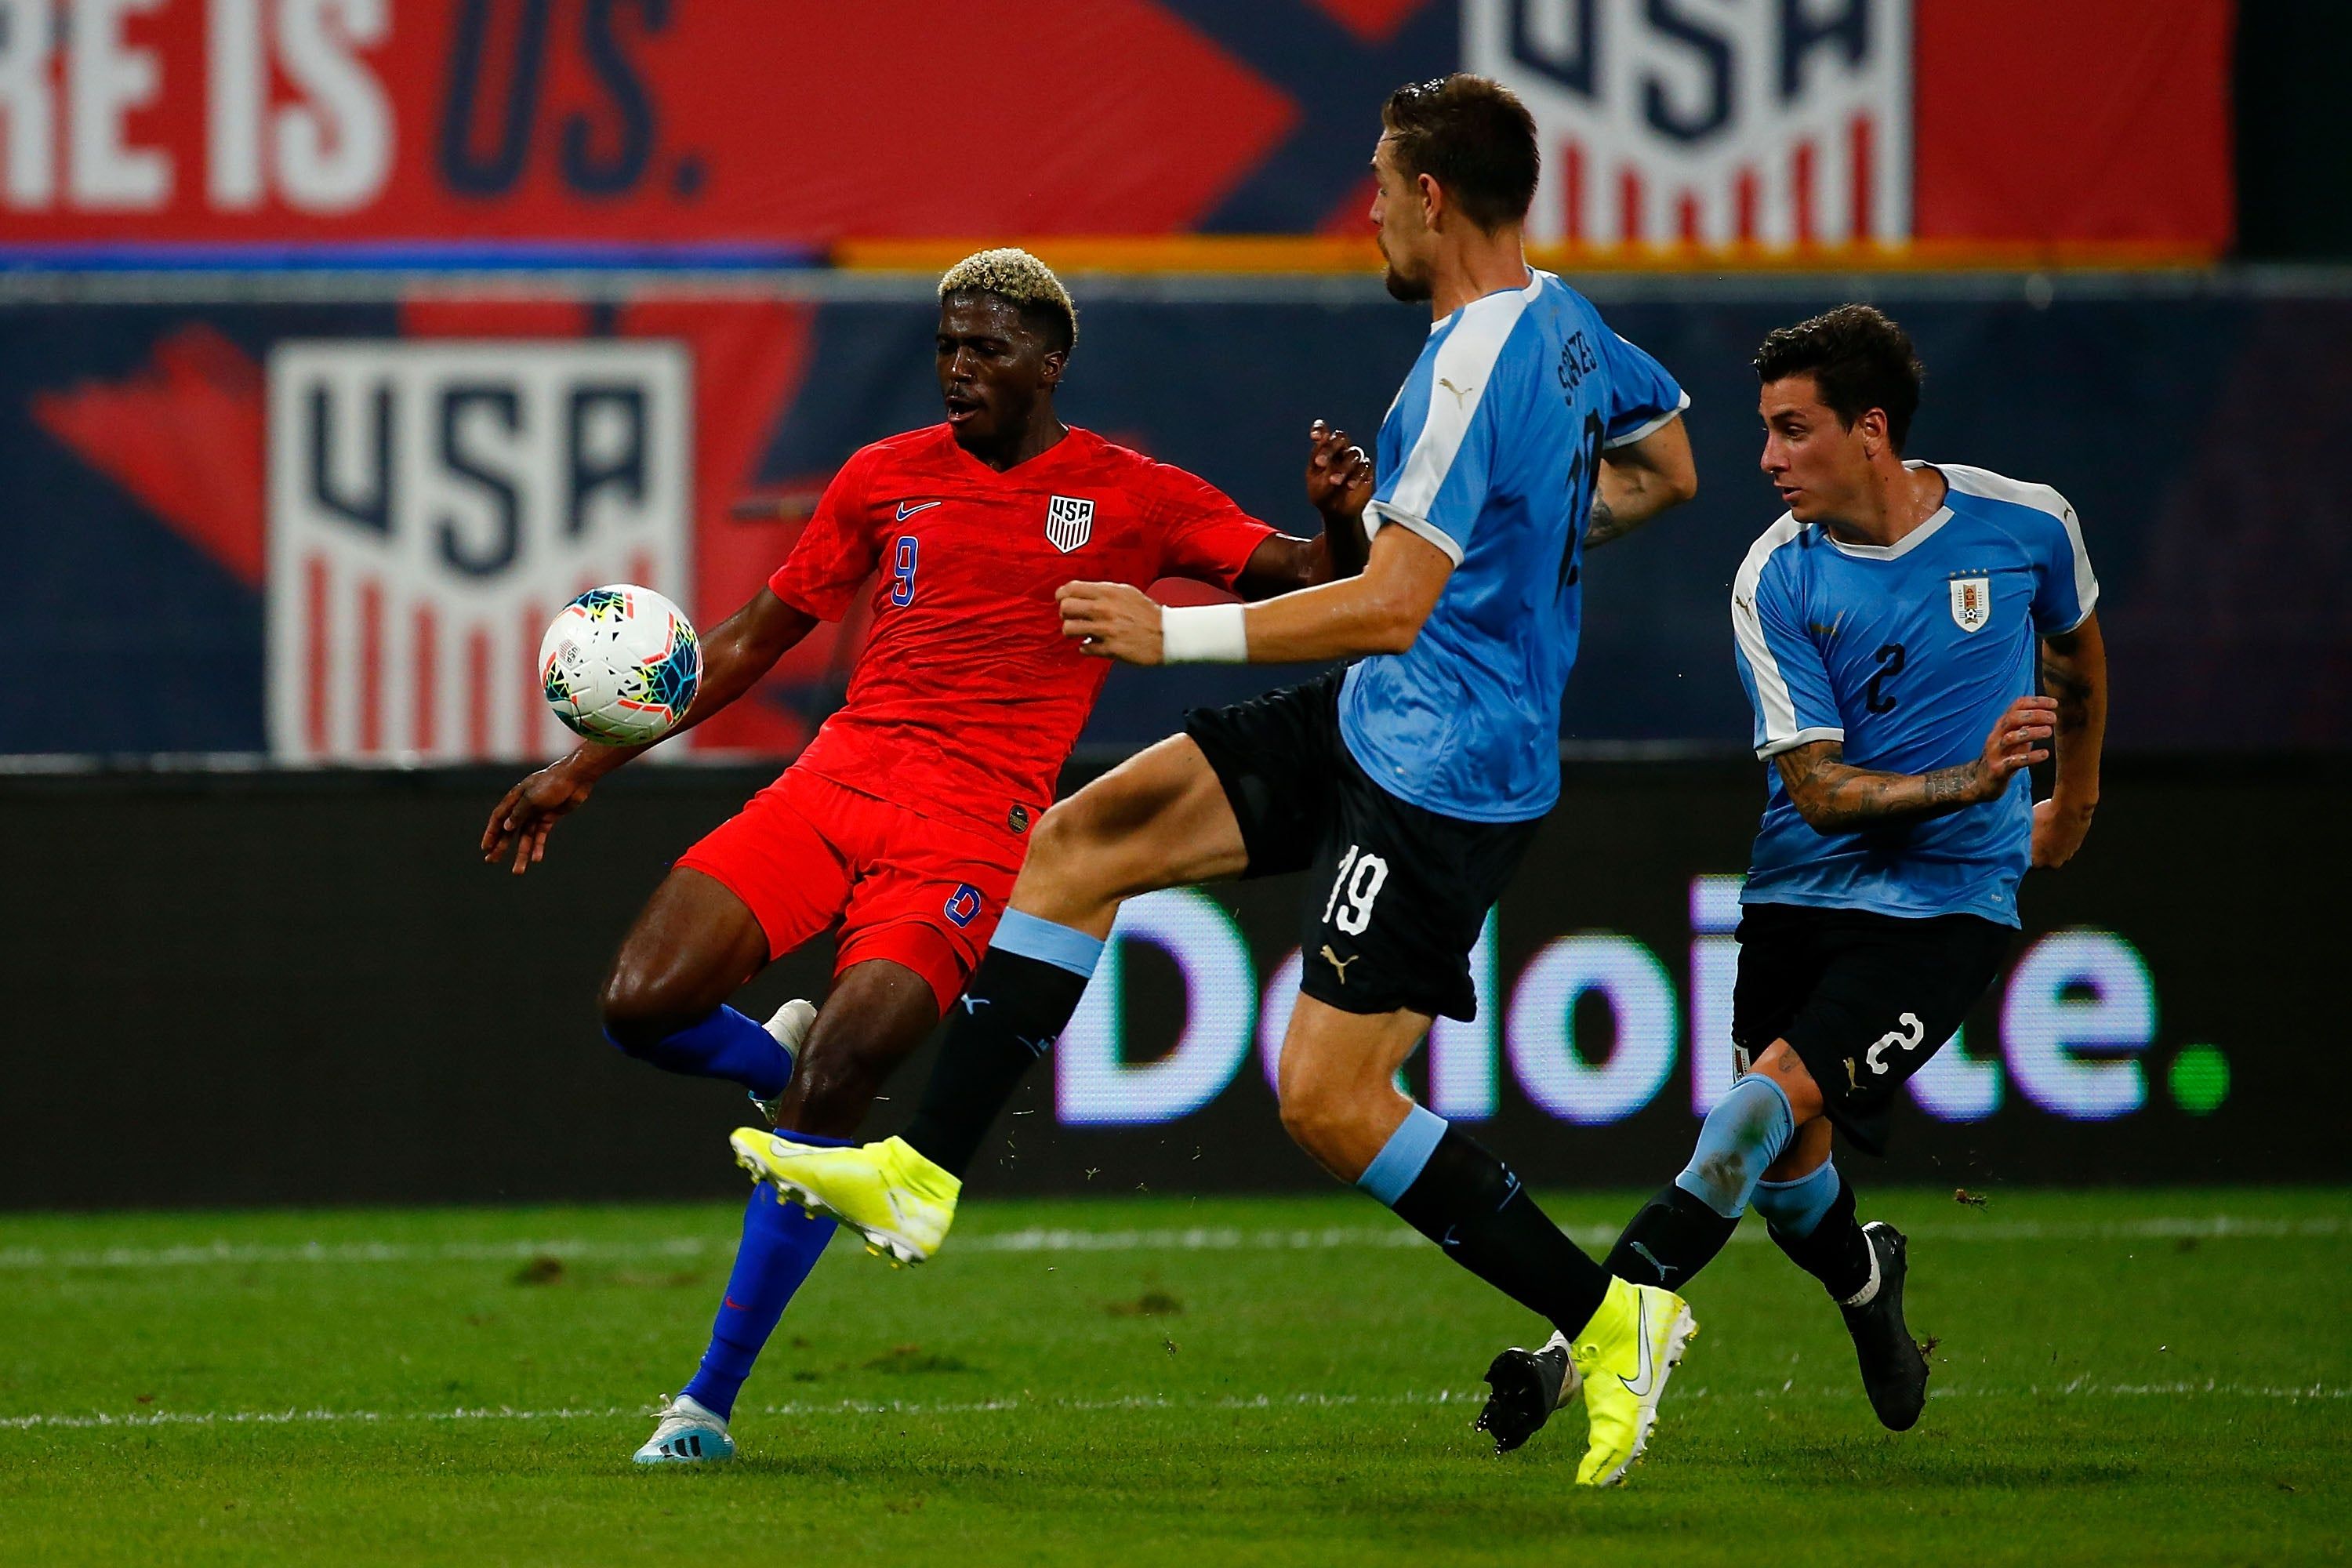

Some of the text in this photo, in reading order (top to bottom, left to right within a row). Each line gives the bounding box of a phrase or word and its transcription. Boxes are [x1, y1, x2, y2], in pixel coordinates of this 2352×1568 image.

[207, 0, 394, 212] IS
[434, 0, 706, 203] US.
[1507, 0, 1869, 142] USA
[307, 379, 651, 581] USA
[1052, 499, 1091, 521] USA
[891, 536, 918, 607] 9
[1965, 588, 1975, 607] AUF
[567, 647, 578, 663] USA
[1865, 643, 1905, 714] 2
[1323, 844, 1389, 936] 19
[1866, 1012, 1924, 1074] 2
